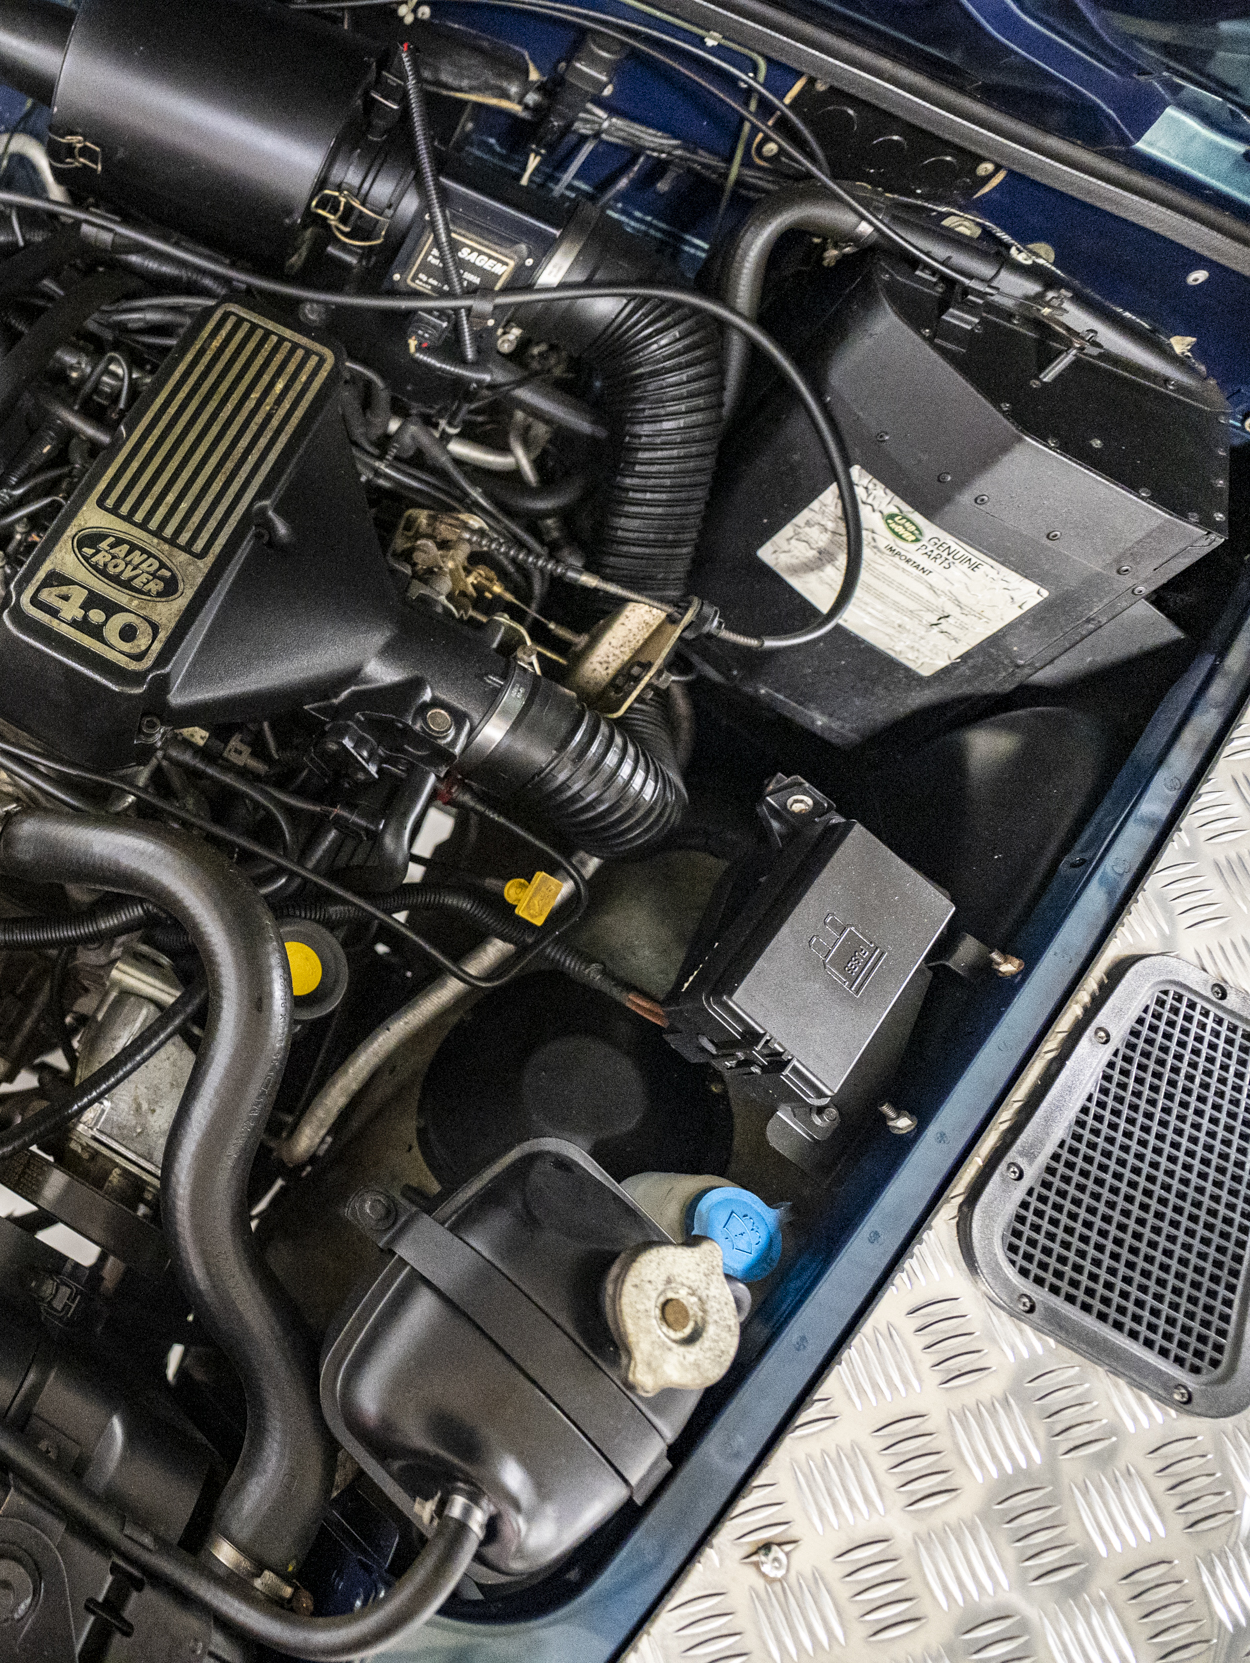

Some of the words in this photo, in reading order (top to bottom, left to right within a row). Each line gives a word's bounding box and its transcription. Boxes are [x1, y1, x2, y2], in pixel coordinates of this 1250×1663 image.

[458, 248, 508, 275] SAGEM
[890, 522, 917, 542] ROVER
[894, 516, 917, 532] LAND
[97, 537, 160, 573] LAND
[884, 544, 933, 576] IMPORTANT
[915, 544, 955, 571] PARTS
[927, 536, 984, 573] GENUINE
[90, 551, 165, 596] ROVER
